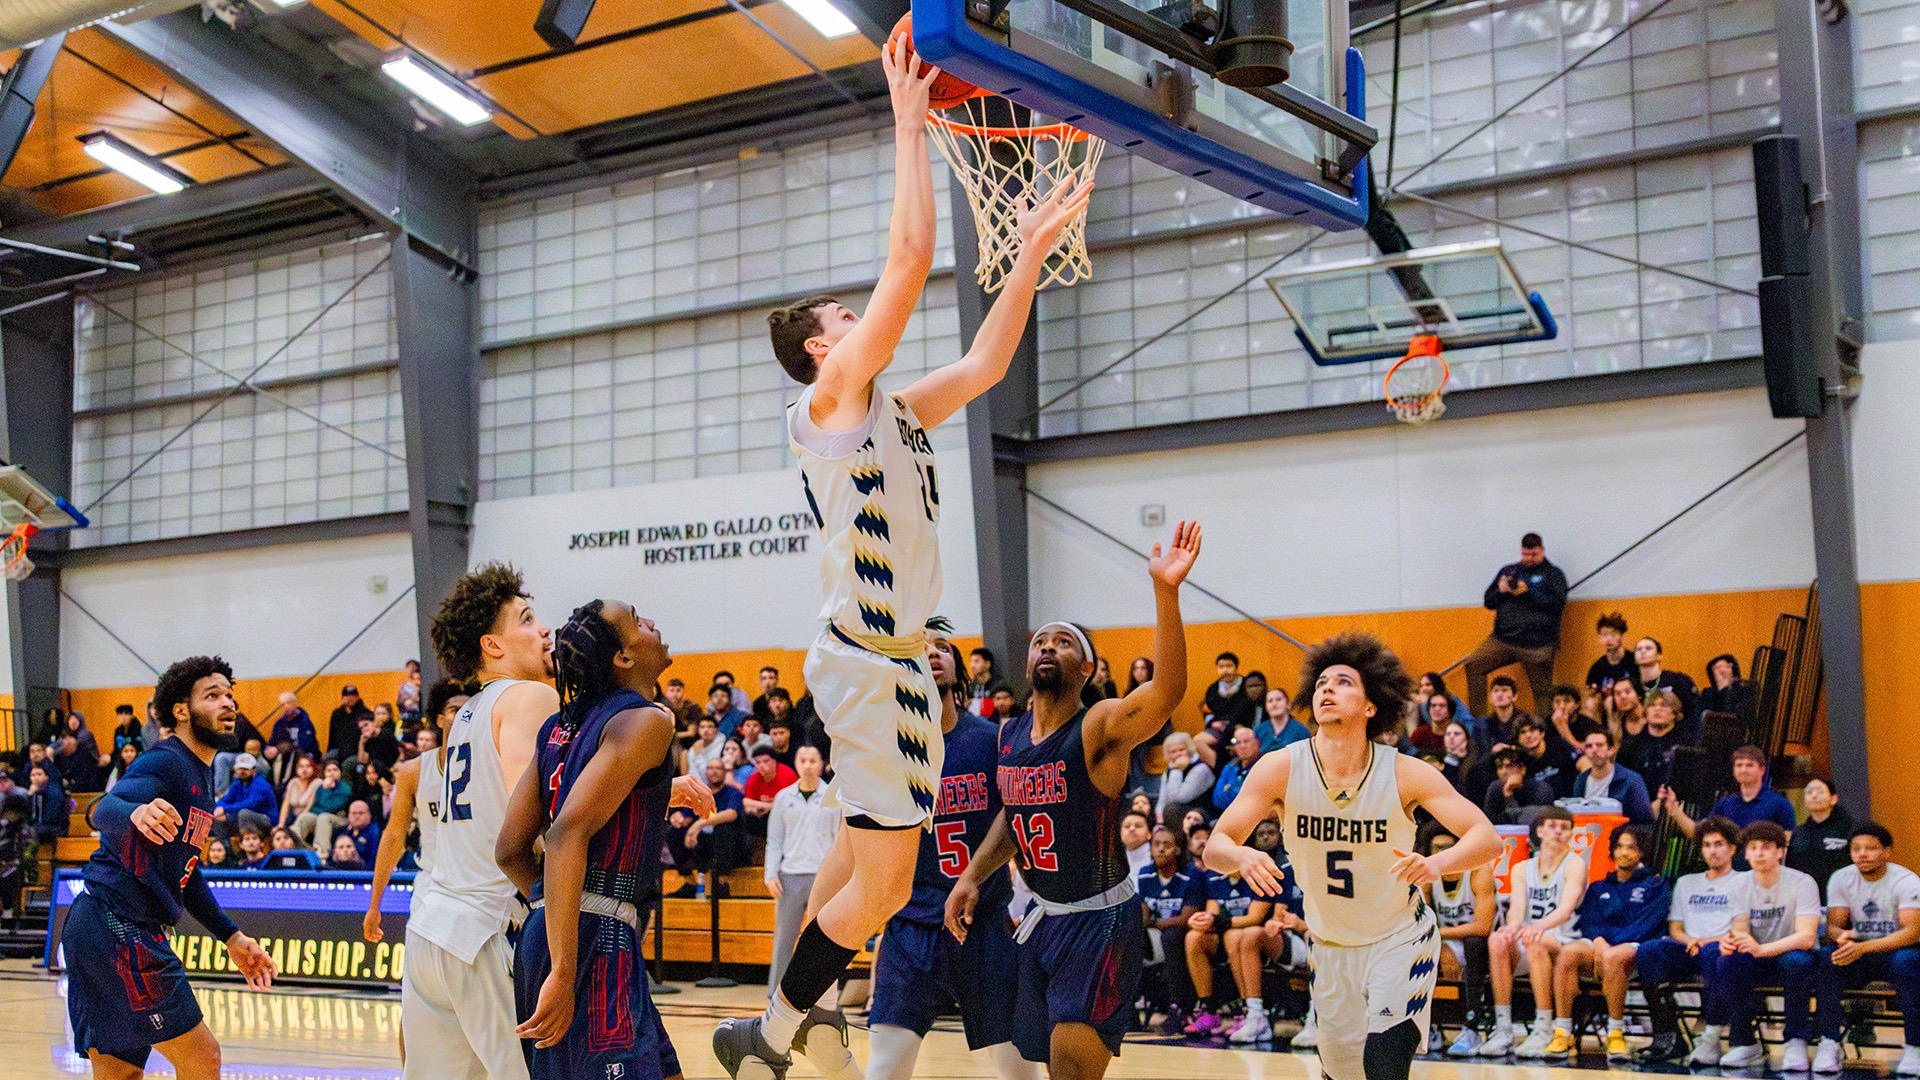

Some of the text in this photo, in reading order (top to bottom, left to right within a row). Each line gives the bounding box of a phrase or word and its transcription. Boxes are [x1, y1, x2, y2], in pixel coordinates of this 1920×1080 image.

[568, 529, 630, 550] JOSEPH
[637, 520, 708, 544] EDWARD
[713, 515, 773, 537] GALLO
[643, 536, 810, 565] HOSTETLER COURT
[934, 772, 989, 817] NEERS
[935, 820, 973, 878] 5
[1012, 812, 1058, 872] 12
[1297, 814, 1387, 843] BOBCATS
[1327, 850, 1354, 898] 5
[169, 935, 405, 980] MERCFANSHOP.CO
